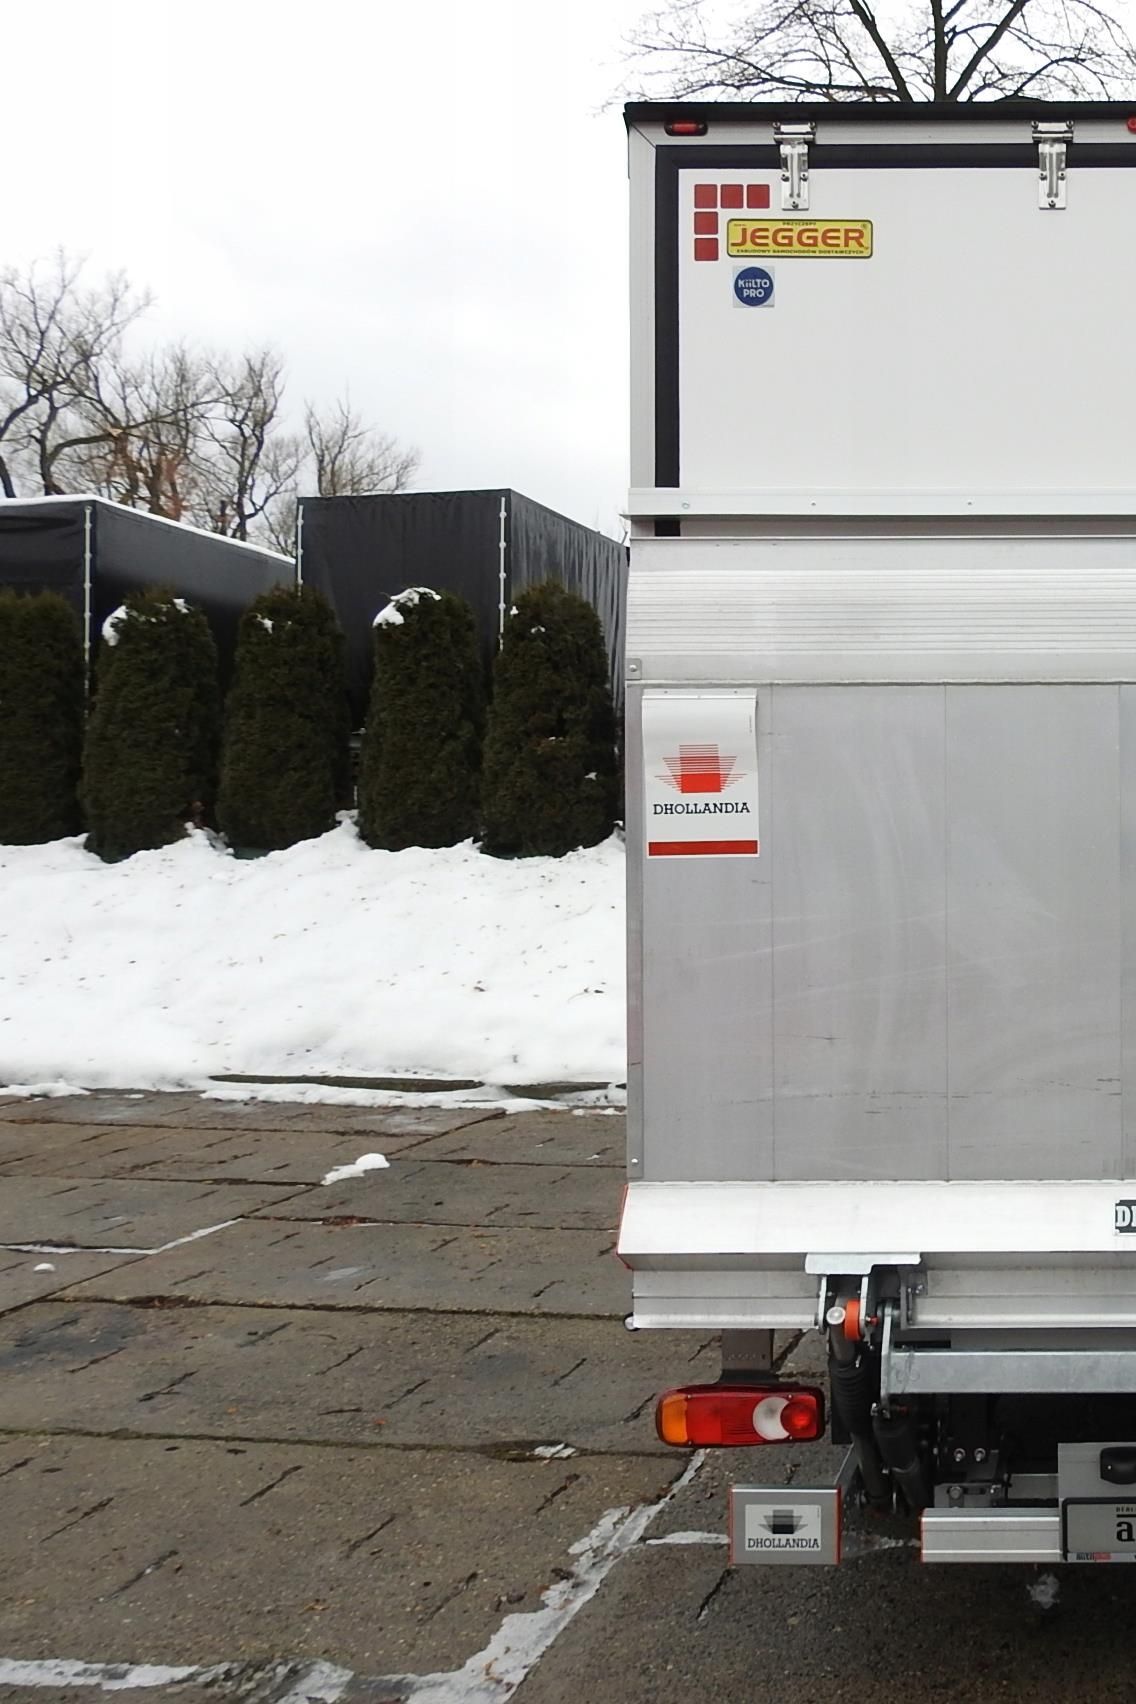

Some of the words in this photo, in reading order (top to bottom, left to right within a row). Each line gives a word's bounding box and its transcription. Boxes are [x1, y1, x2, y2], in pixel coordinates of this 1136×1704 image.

[730, 227, 865, 248] JEGGER
[743, 288, 765, 298] PRO
[653, 802, 750, 815] DHOLLANDIA
[747, 1537, 820, 1549] DHOLLANDIA
